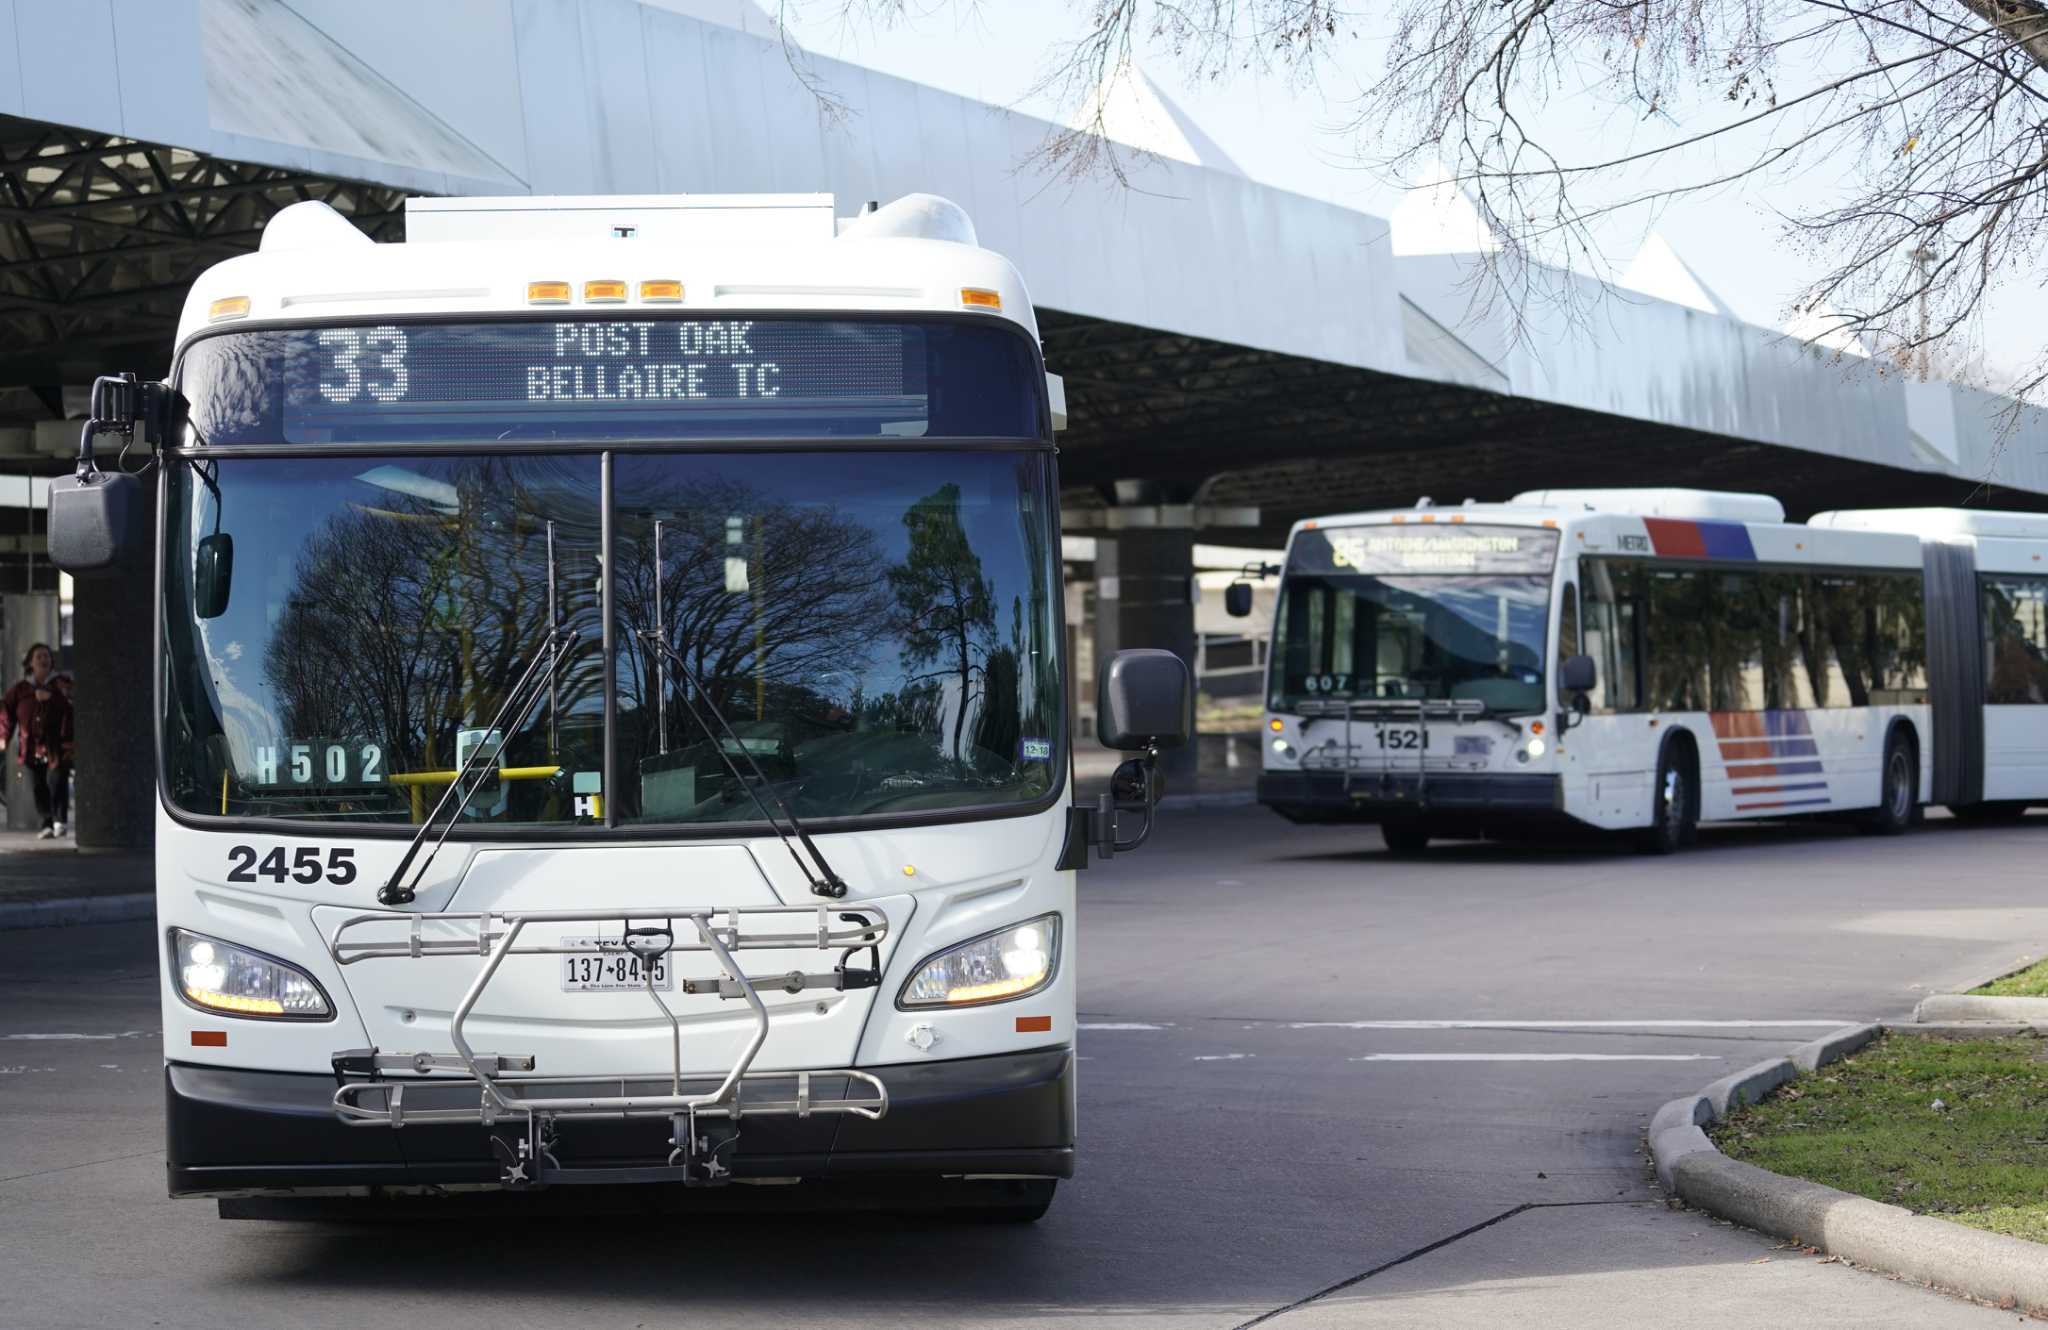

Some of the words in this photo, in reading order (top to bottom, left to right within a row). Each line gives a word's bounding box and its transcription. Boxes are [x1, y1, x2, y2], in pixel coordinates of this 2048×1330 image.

[555, 323, 654, 356] POST
[679, 321, 754, 355] OAK
[319, 326, 409, 402] 33
[527, 363, 707, 400] BELLAIRE
[734, 362, 781, 397] TC
[1616, 535, 1649, 551] METRO
[1305, 676, 1347, 690] 607
[1376, 730, 1429, 749] 1521
[257, 744, 382, 785] H502
[227, 846, 357, 885] 2455
[568, 958, 604, 982] 137
[616, 957, 665, 981] 845
